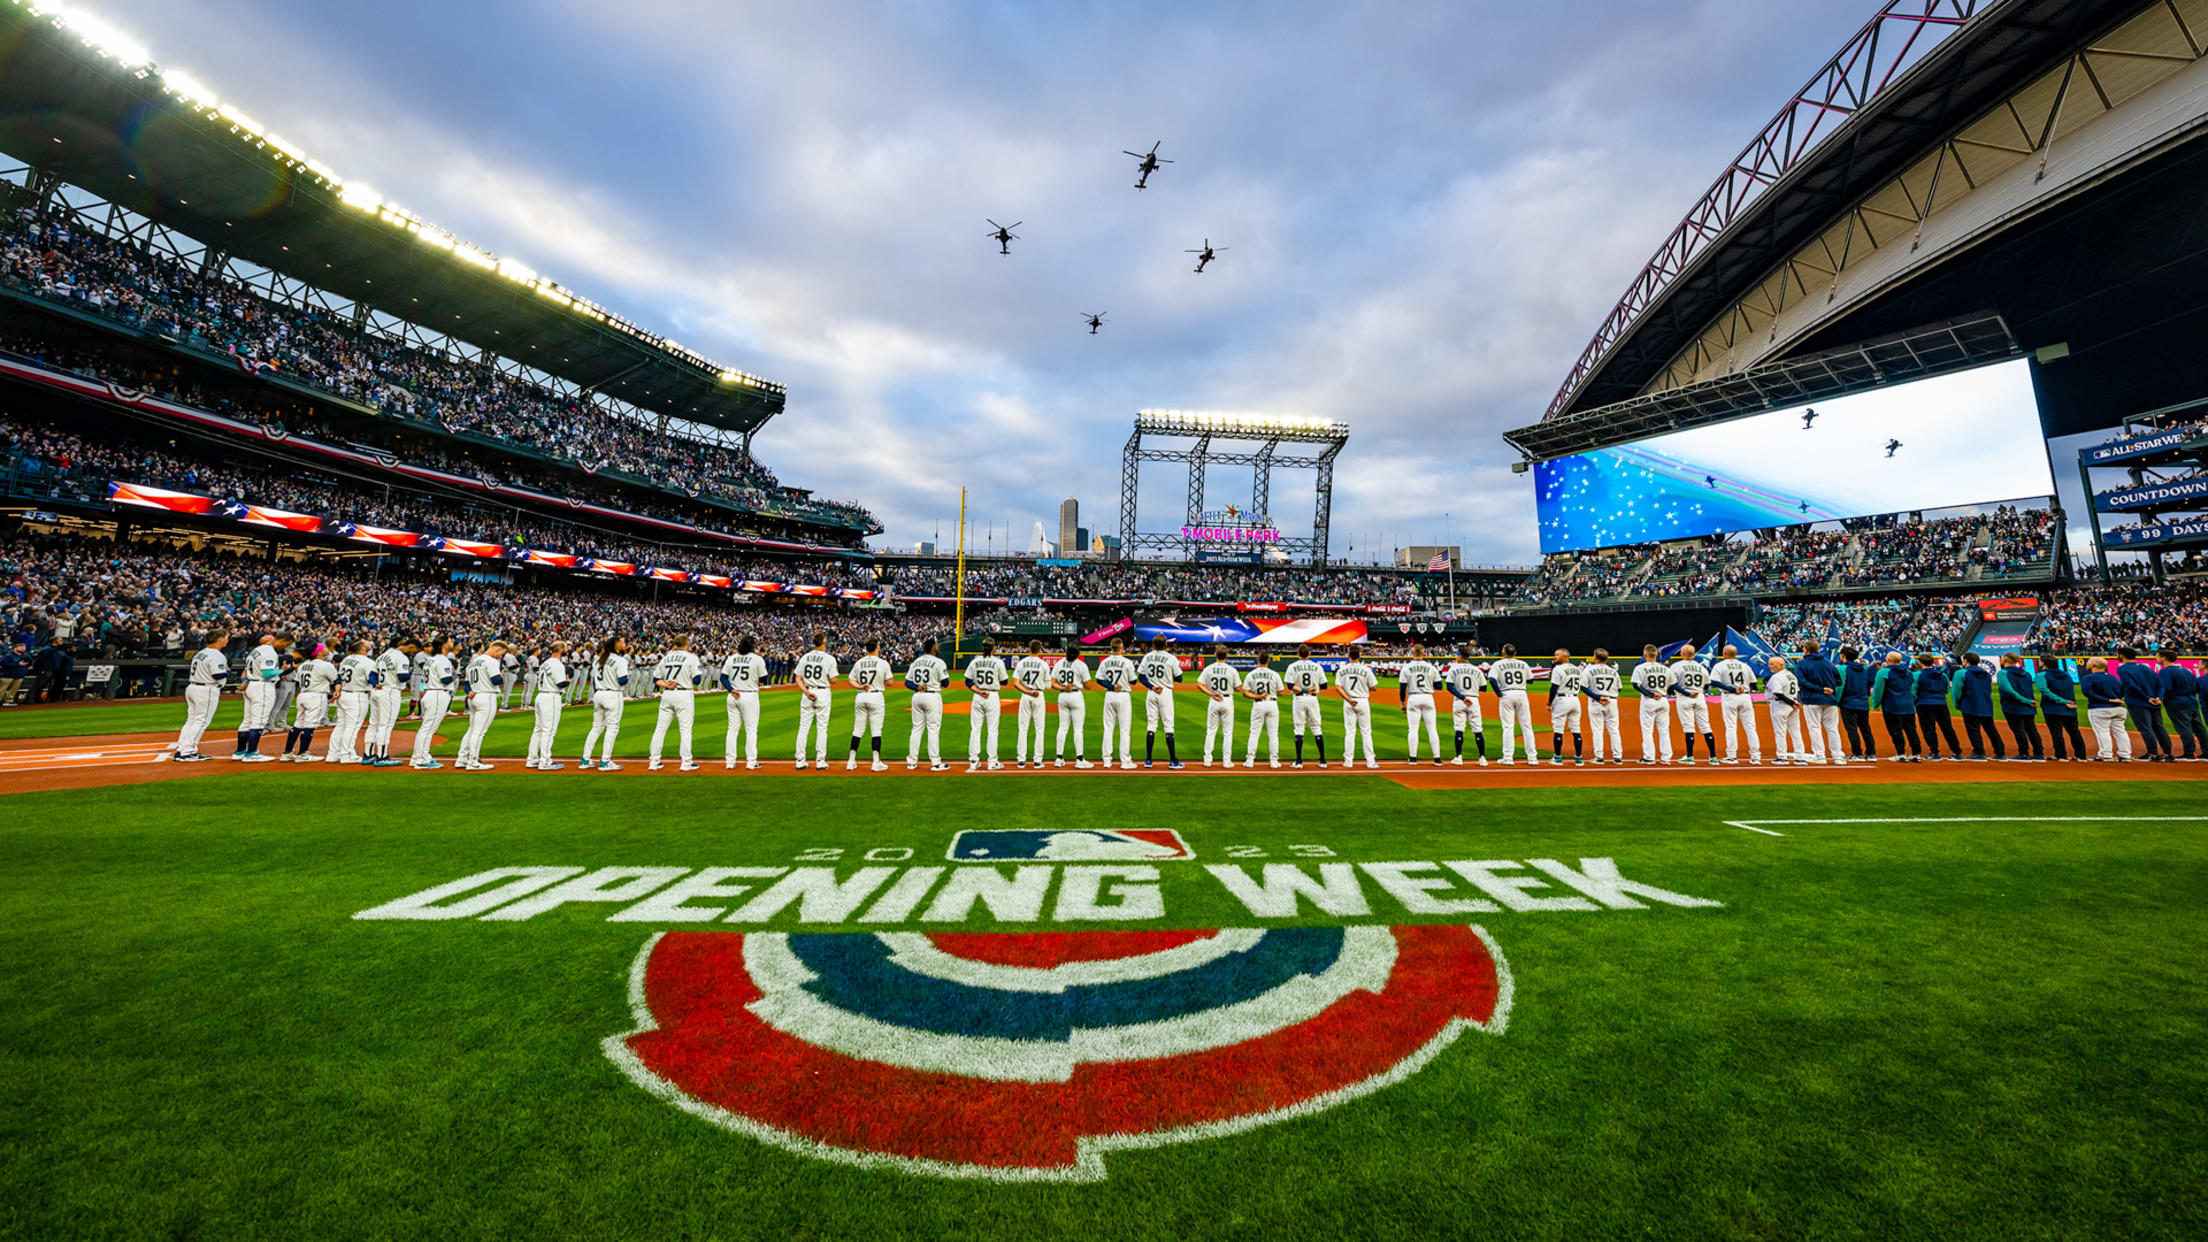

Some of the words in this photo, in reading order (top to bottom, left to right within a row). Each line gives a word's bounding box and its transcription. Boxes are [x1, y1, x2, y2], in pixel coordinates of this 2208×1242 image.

[2110, 482, 2207, 505] COUNTDOWN
[1246, 529, 1281, 542] PARK
[2141, 529, 2161, 539] 99
[341, 667, 353, 683] 23
[470, 668, 479, 684] 10
[665, 665, 682, 680] 77
[732, 666, 750, 681] 75
[804, 664, 822, 680] 68
[859, 670, 877, 685] 67
[914, 669, 930, 683] 63
[976, 670, 994, 685] 56
[1022, 670, 1040, 685] 47
[1059, 670, 1074, 684] 38
[1105, 670, 1123, 684] 37
[1148, 664, 1165, 679] 36
[1504, 671, 1524, 685] 89
[1729, 671, 1744, 685] 14
[300, 673, 312, 688] 16
[1211, 677, 1228, 691] 30
[1302, 673, 1311, 687] 8
[1349, 676, 1358, 690] 7
[1416, 674, 1425, 688] 2
[1463, 676, 1472, 690] 0
[1565, 677, 1579, 691] 45
[1596, 677, 1614, 691] 57
[1647, 675, 1666, 689] 88
[1684, 673, 1703, 687] 39
[1256, 682, 1271, 695] 21
[1790, 681, 1796, 695] 6
[795, 848, 914, 860] 20
[1225, 843, 1338, 858] 23
[351, 864, 1165, 922] OPENING
[1204, 857, 1726, 918] WEEK
